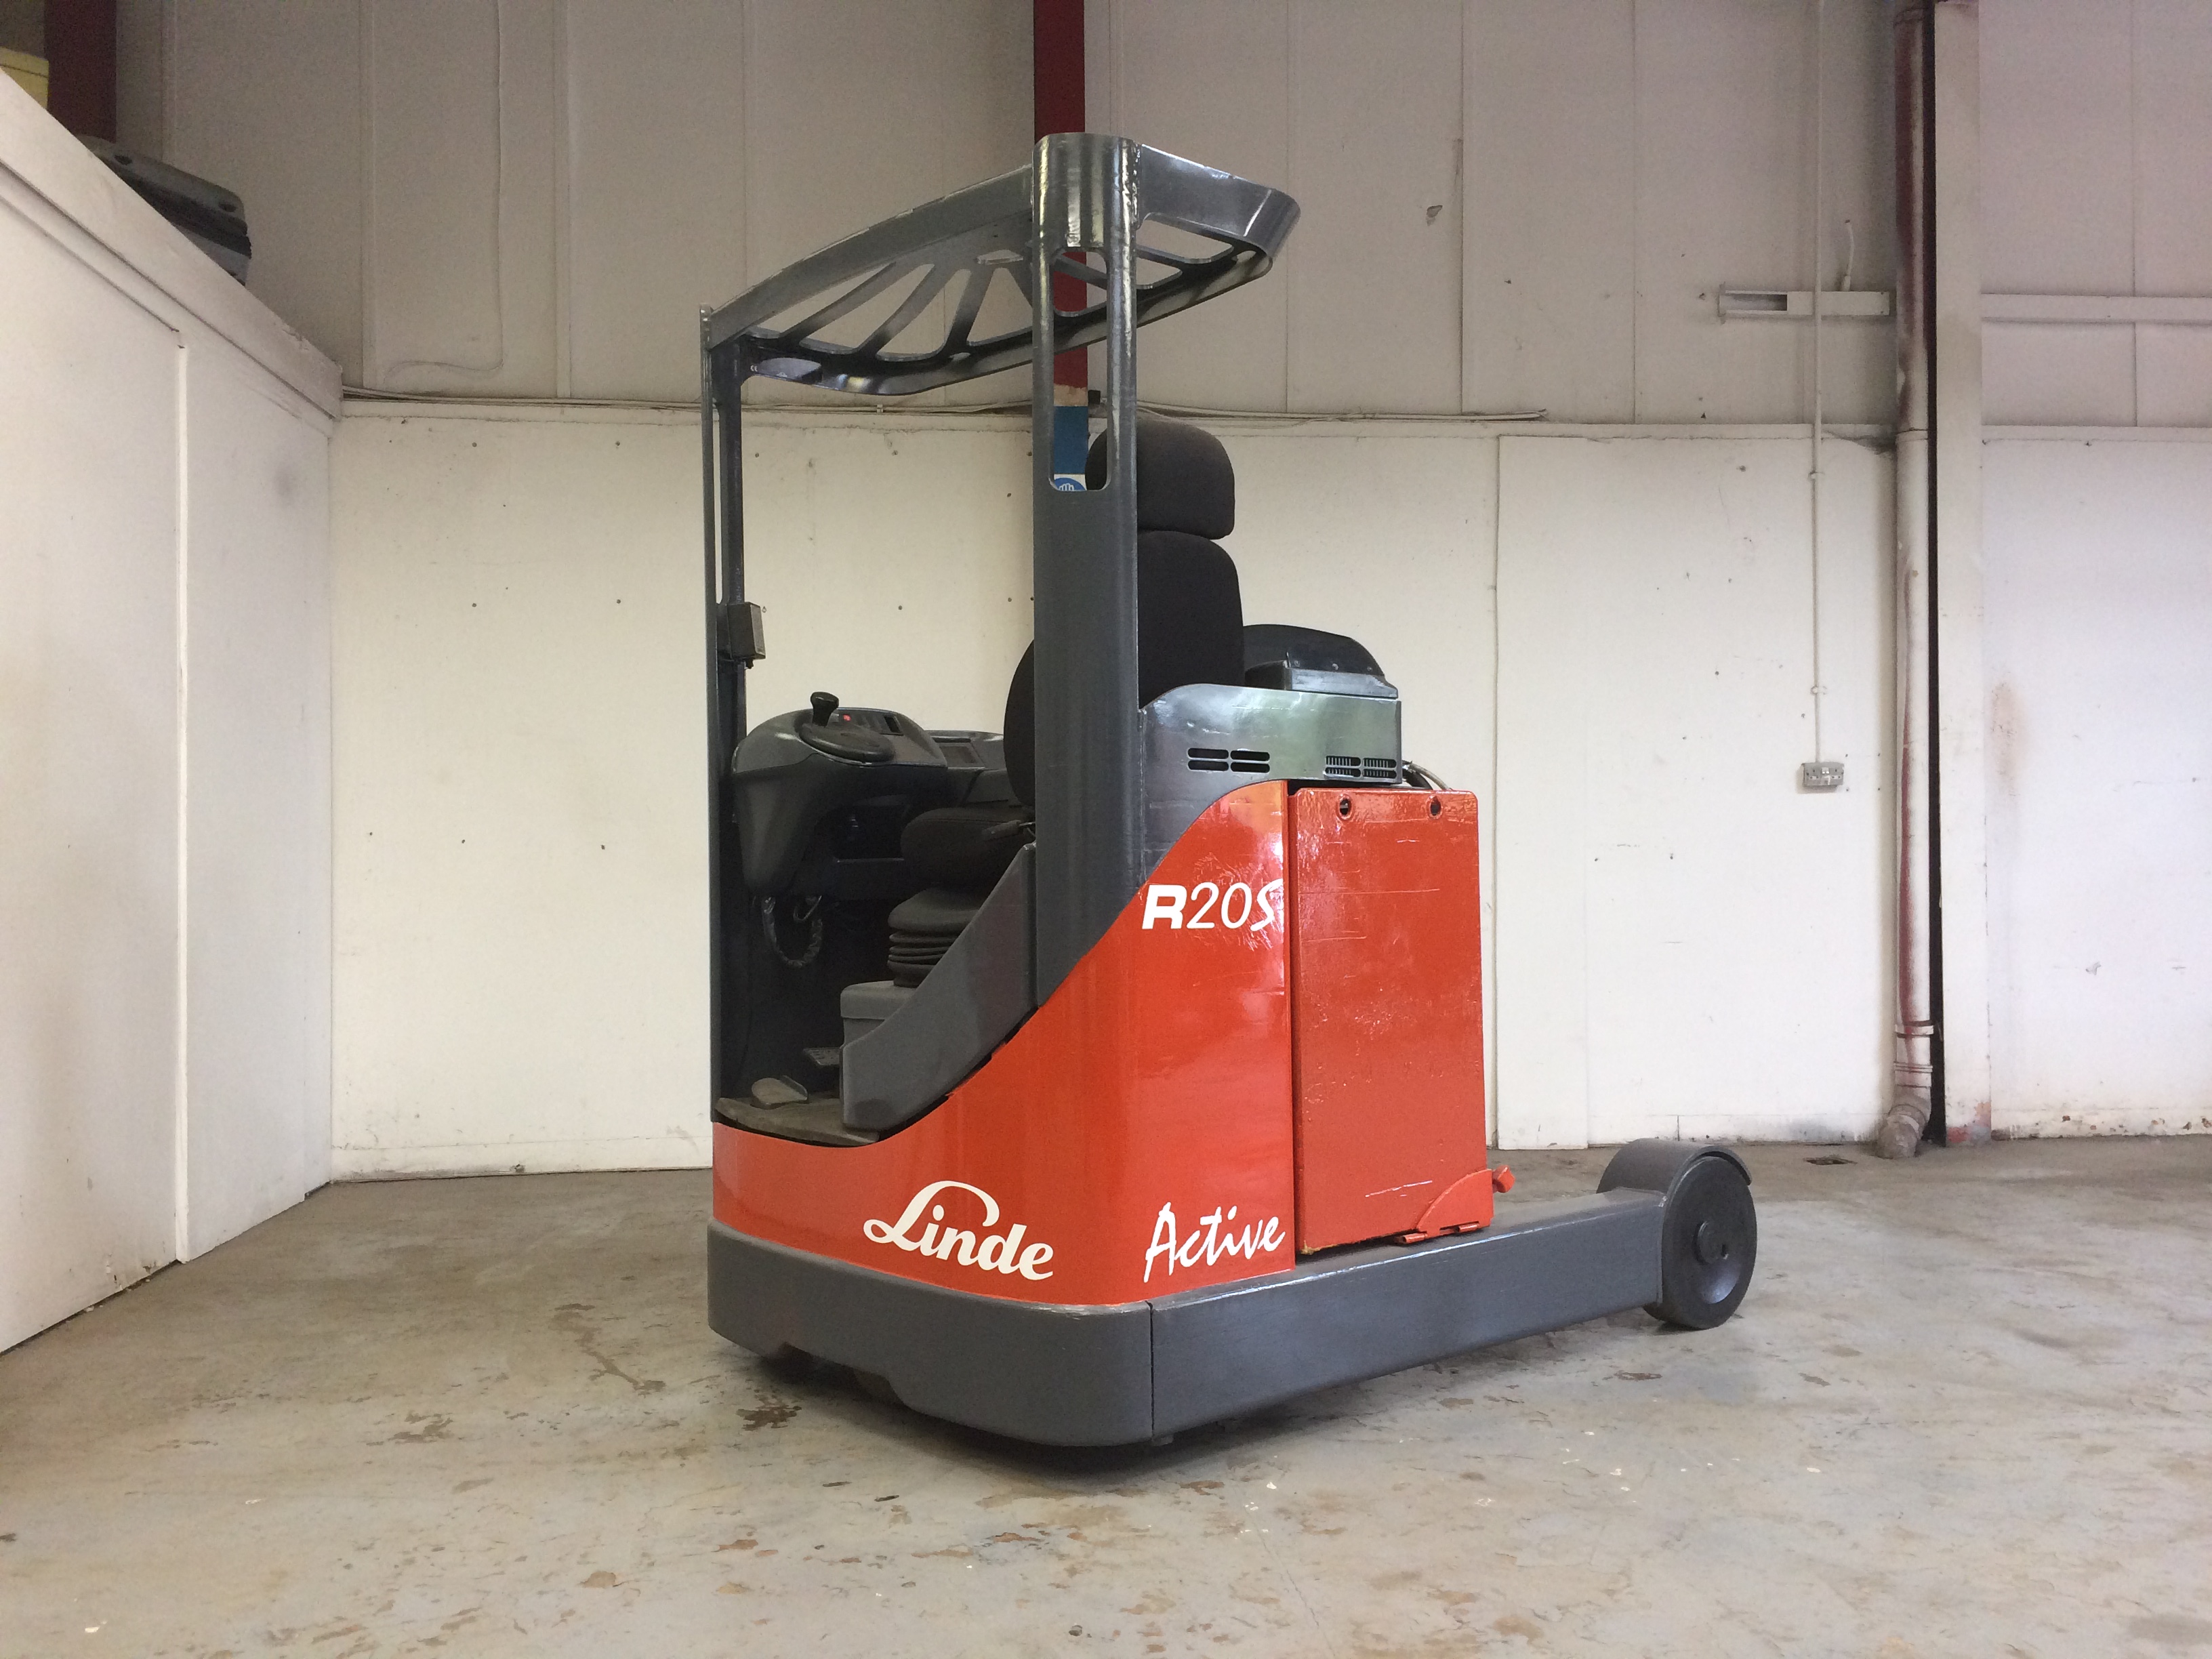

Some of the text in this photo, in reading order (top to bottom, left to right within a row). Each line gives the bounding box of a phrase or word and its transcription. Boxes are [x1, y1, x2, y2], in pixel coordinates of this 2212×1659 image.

[1142, 878, 1283, 932] R20S
[863, 1181, 1054, 1280] Linde
[1143, 1202, 1286, 1283] Active
